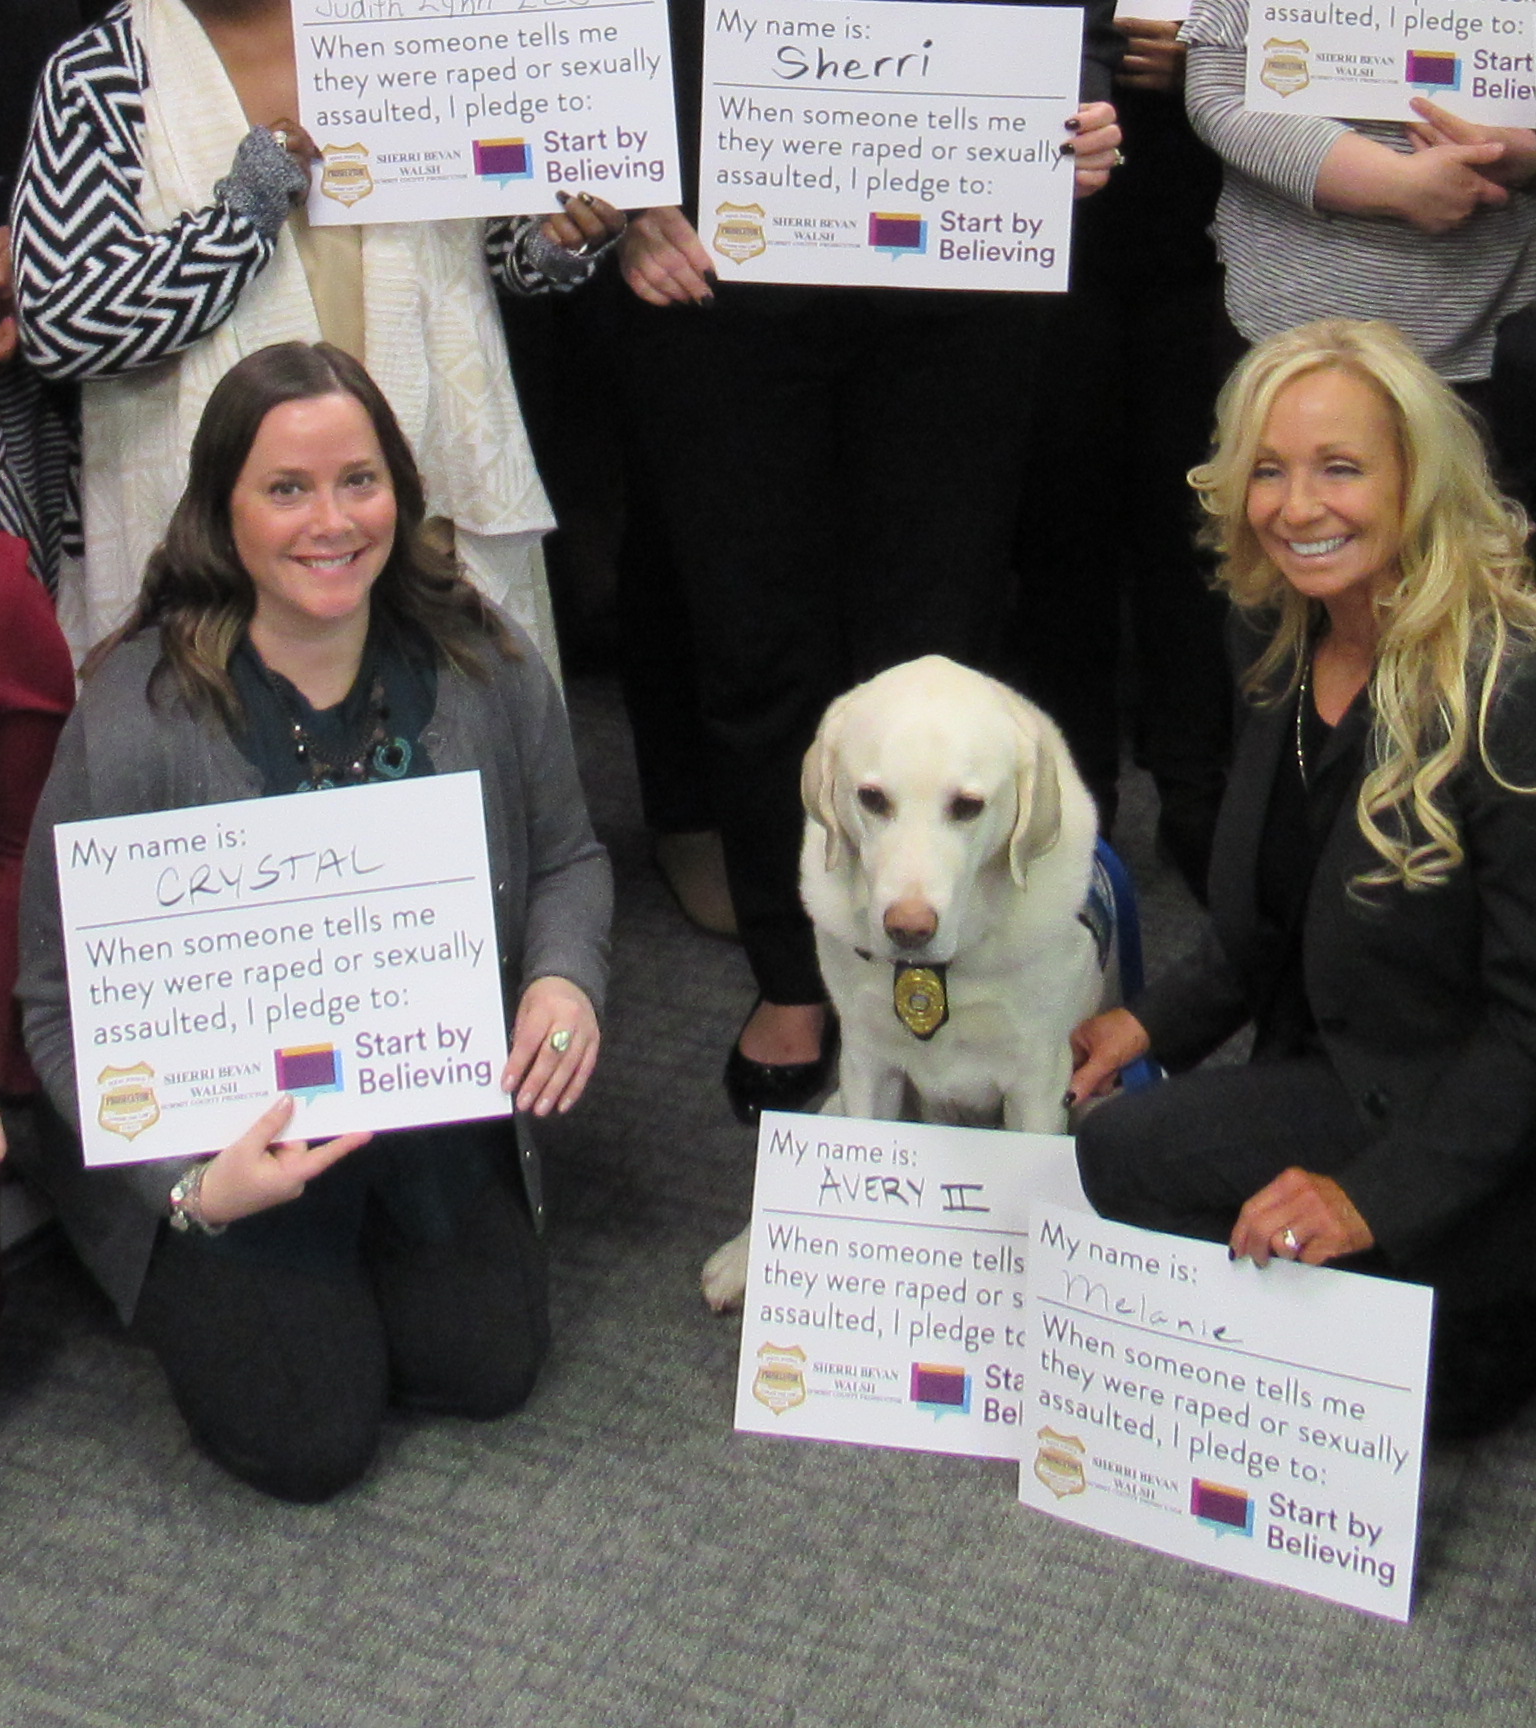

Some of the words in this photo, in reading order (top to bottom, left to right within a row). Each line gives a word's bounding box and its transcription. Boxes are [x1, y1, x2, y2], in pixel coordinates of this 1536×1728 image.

[771, 39, 934, 81] Sherri
[71, 837, 117, 874] My
[128, 834, 206, 860] name
[216, 822, 246, 849] is:
[155, 844, 387, 908] CRYSTAL
[85, 936, 172, 967] When
[183, 923, 313, 956] someone
[323, 905, 382, 938] tells
[392, 908, 435, 929] me
[89, 975, 154, 1010] they
[163, 970, 232, 995] were
[243, 948, 323, 992] raped
[334, 953, 363, 973] or
[373, 930, 484, 969] sexually
[93, 1000, 236, 1045] assaulted,
[247, 997, 253, 1025] I
[266, 987, 360, 1034] pledge
[370, 987, 408, 1009] to:
[355, 1028, 427, 1059] Start
[437, 1022, 472, 1053] by
[163, 1068, 214, 1084] SHERRI
[218, 1063, 260, 1078] BEVAN
[190, 1081, 237, 1097] WALSH
[358, 1056, 491, 1095] Believing
[817, 1166, 929, 1207] AVERY
[939, 1180, 991, 1214] II
[1061, 1268, 1244, 1344] Melanie
